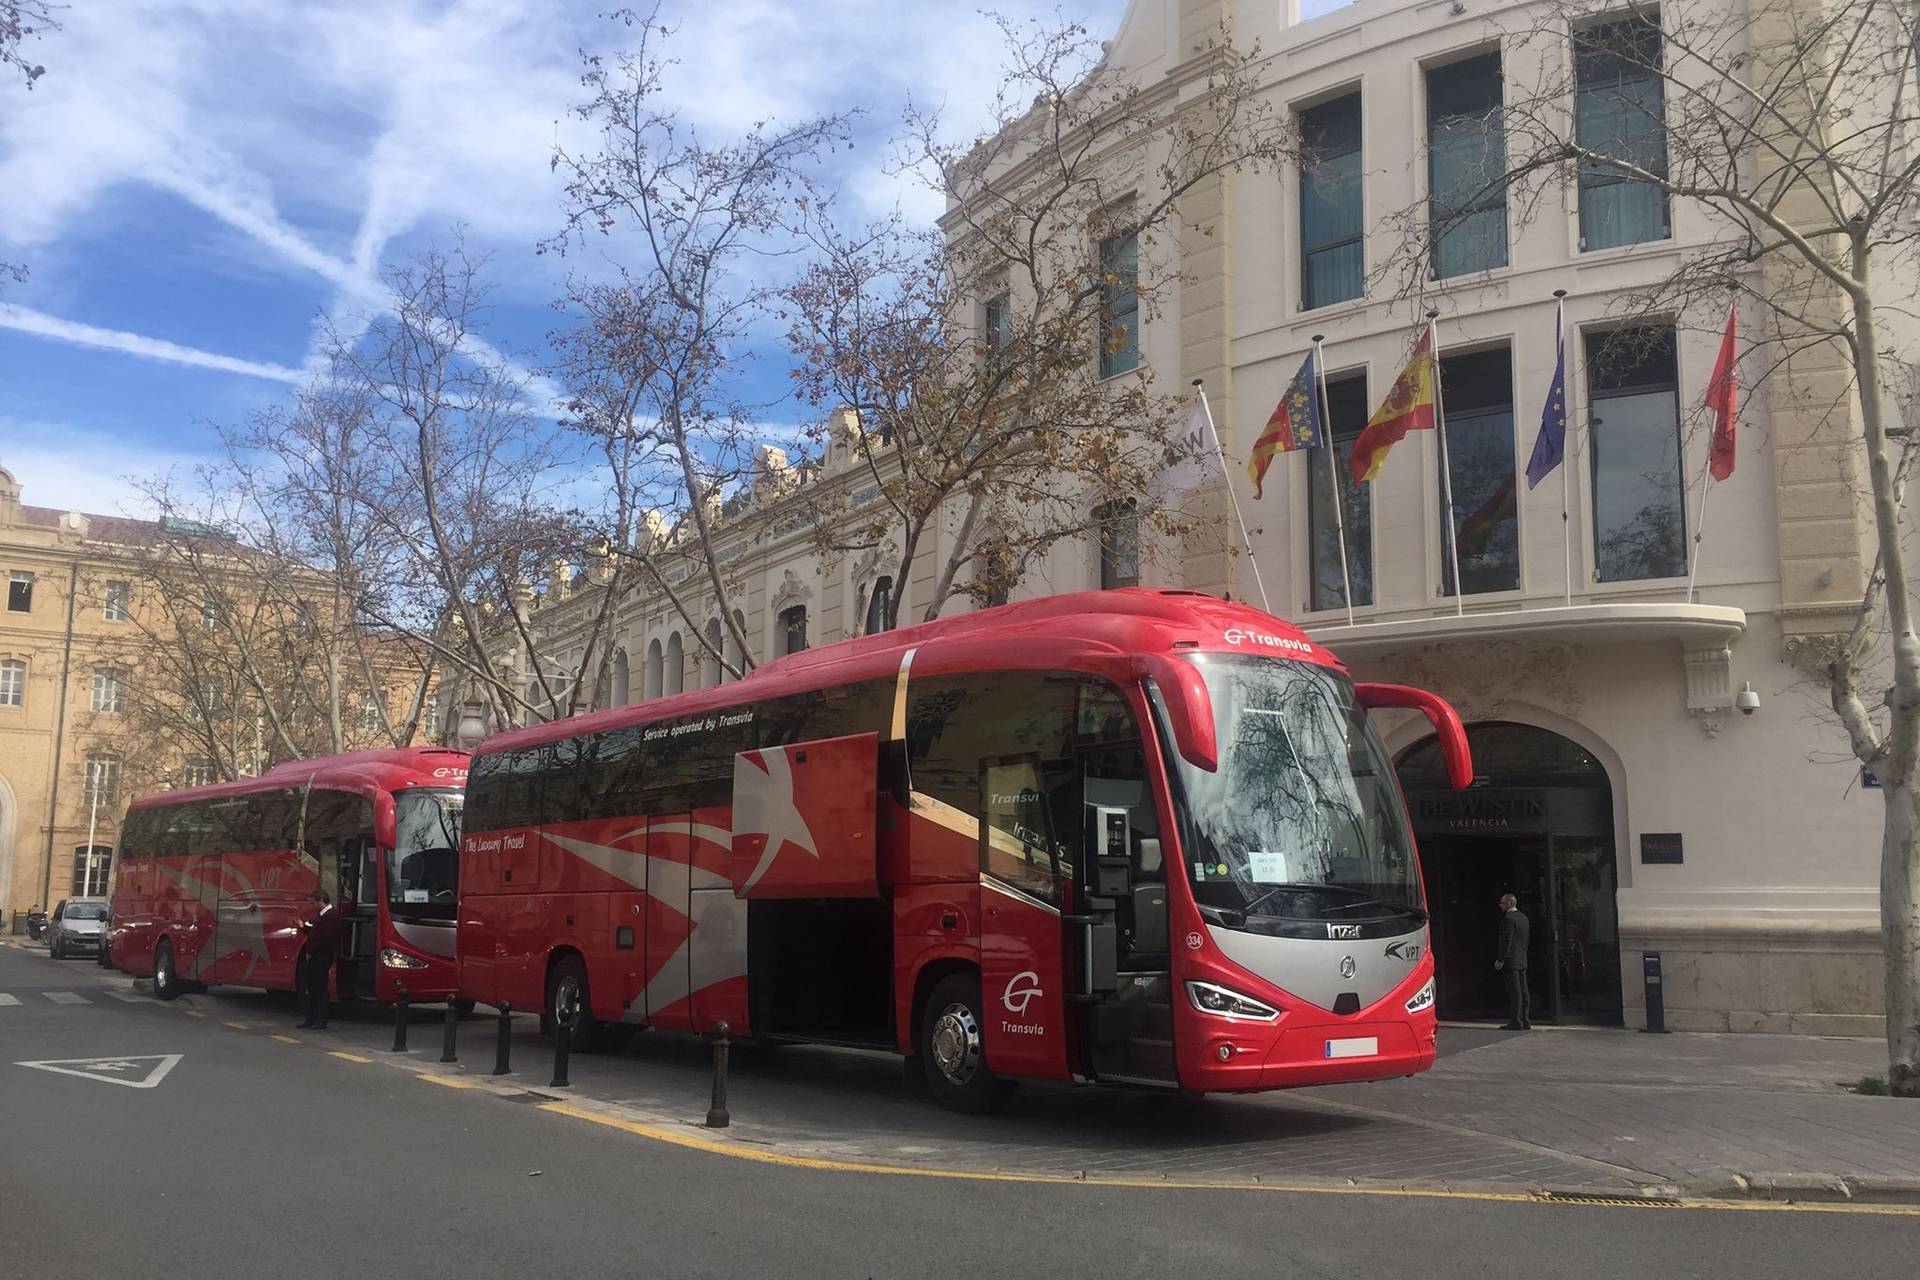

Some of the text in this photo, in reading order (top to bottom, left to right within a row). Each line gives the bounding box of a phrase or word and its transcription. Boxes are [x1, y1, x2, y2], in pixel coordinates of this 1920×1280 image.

[1245, 630, 1313, 653] Transvia
[643, 710, 754, 741] Service operated by Transvia
[991, 793, 1041, 805] Transvi
[1420, 798, 1449, 816] HE
[1449, 818, 1509, 828] VALENCIA
[464, 833, 525, 854] The Luxury Travel
[1326, 922, 1362, 939] Irizar
[1187, 935, 1201, 945] 334
[1405, 946, 1420, 958] VPT
[1002, 1021, 1044, 1035] Transvia
